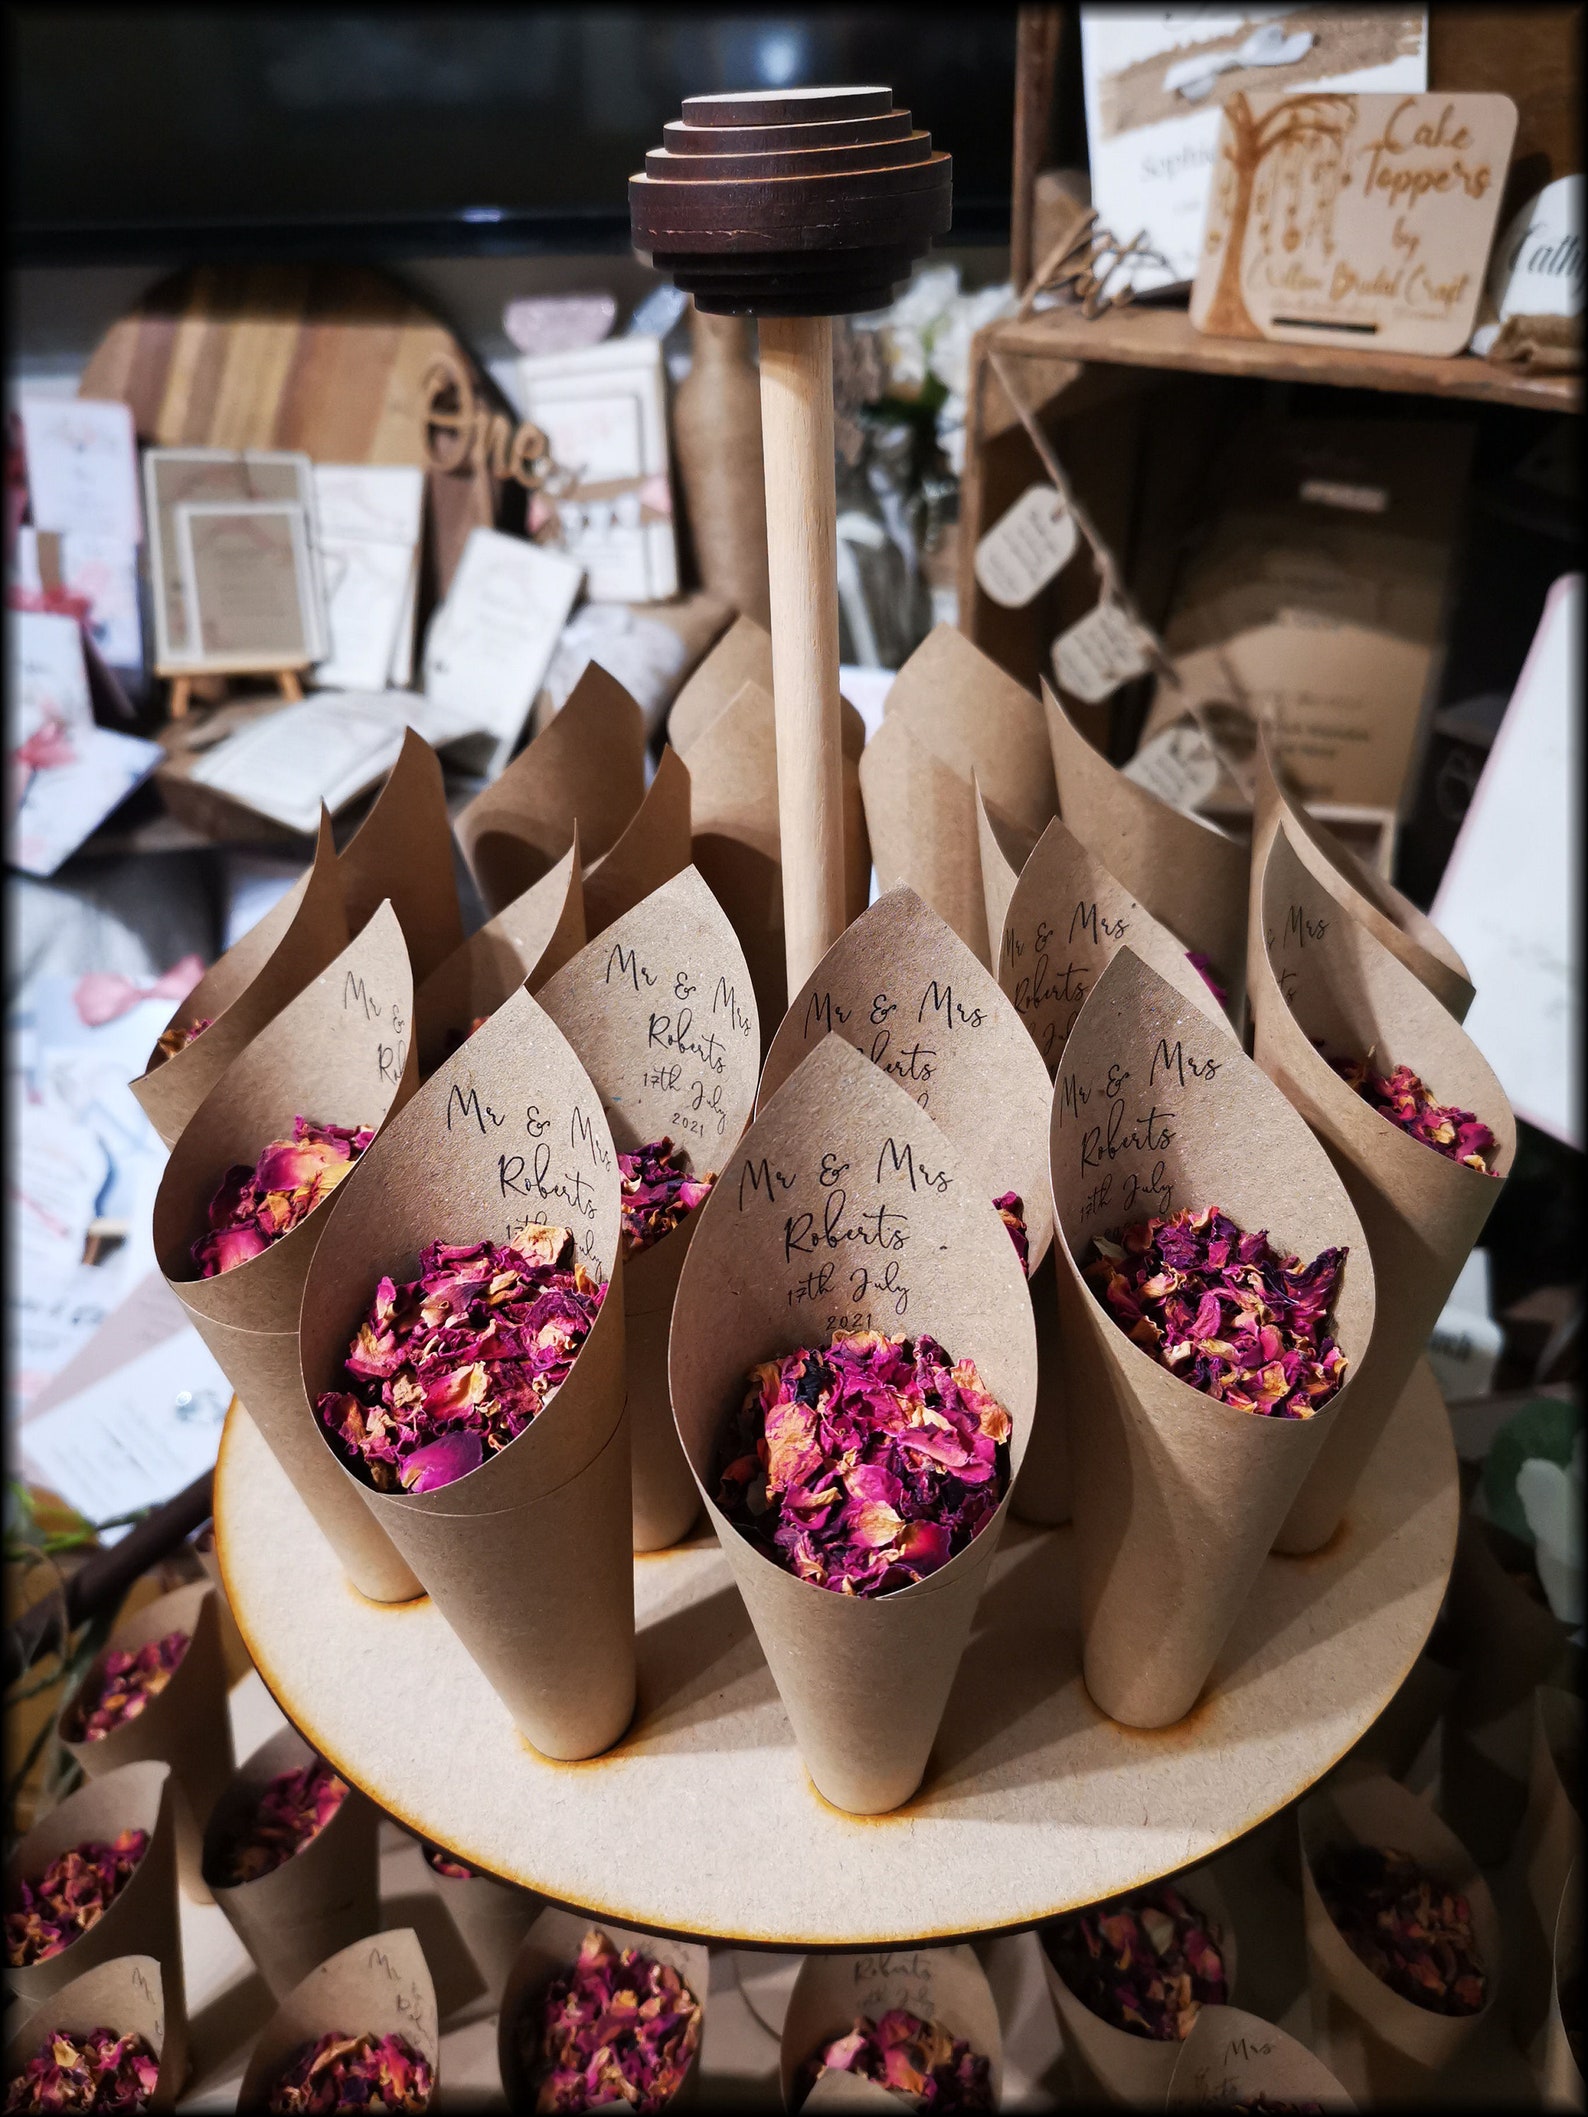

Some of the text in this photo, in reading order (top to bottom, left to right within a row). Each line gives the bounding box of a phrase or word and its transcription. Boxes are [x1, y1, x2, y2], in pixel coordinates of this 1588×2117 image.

[1383, 97, 1473, 153] Cake
[1360, 139, 1491, 208] Toppers
[1392, 215, 1420, 262] by
[419, 351, 552, 490] One
[1034, 922, 1054, 953] &
[1068, 900, 1131, 945] Mrs
[1282, 904, 1331, 948] Mrs
[344, 970, 406, 1034] Mr &
[605, 943, 751, 1037] Mr & Mrs
[803, 979, 988, 1040] Mr & Mrs
[1014, 953, 1091, 1015] Roberts
[648, 1007, 727, 1074] Roberts
[856, 1029, 937, 1082] berts
[1042, 1010, 1078, 1057] Jul
[643, 1063, 728, 1136] 17th July
[1060, 1038, 1223, 1129] Mr & Mrs
[447, 1084, 612, 1173] Mr & Mrs
[671, 1112, 704, 1137] 2021
[1080, 1098, 1177, 1180] Roberts
[497, 1142, 599, 1220] Roberts
[738, 1137, 953, 1212] Mr & Mrs
[1080, 1160, 1175, 1223] 17th July
[783, 1189, 911, 1264] Roberts
[787, 1260, 910, 1315] 17th July
[825, 1313, 873, 1331] 2021
[1223, 2037, 1278, 2066] Mrs
